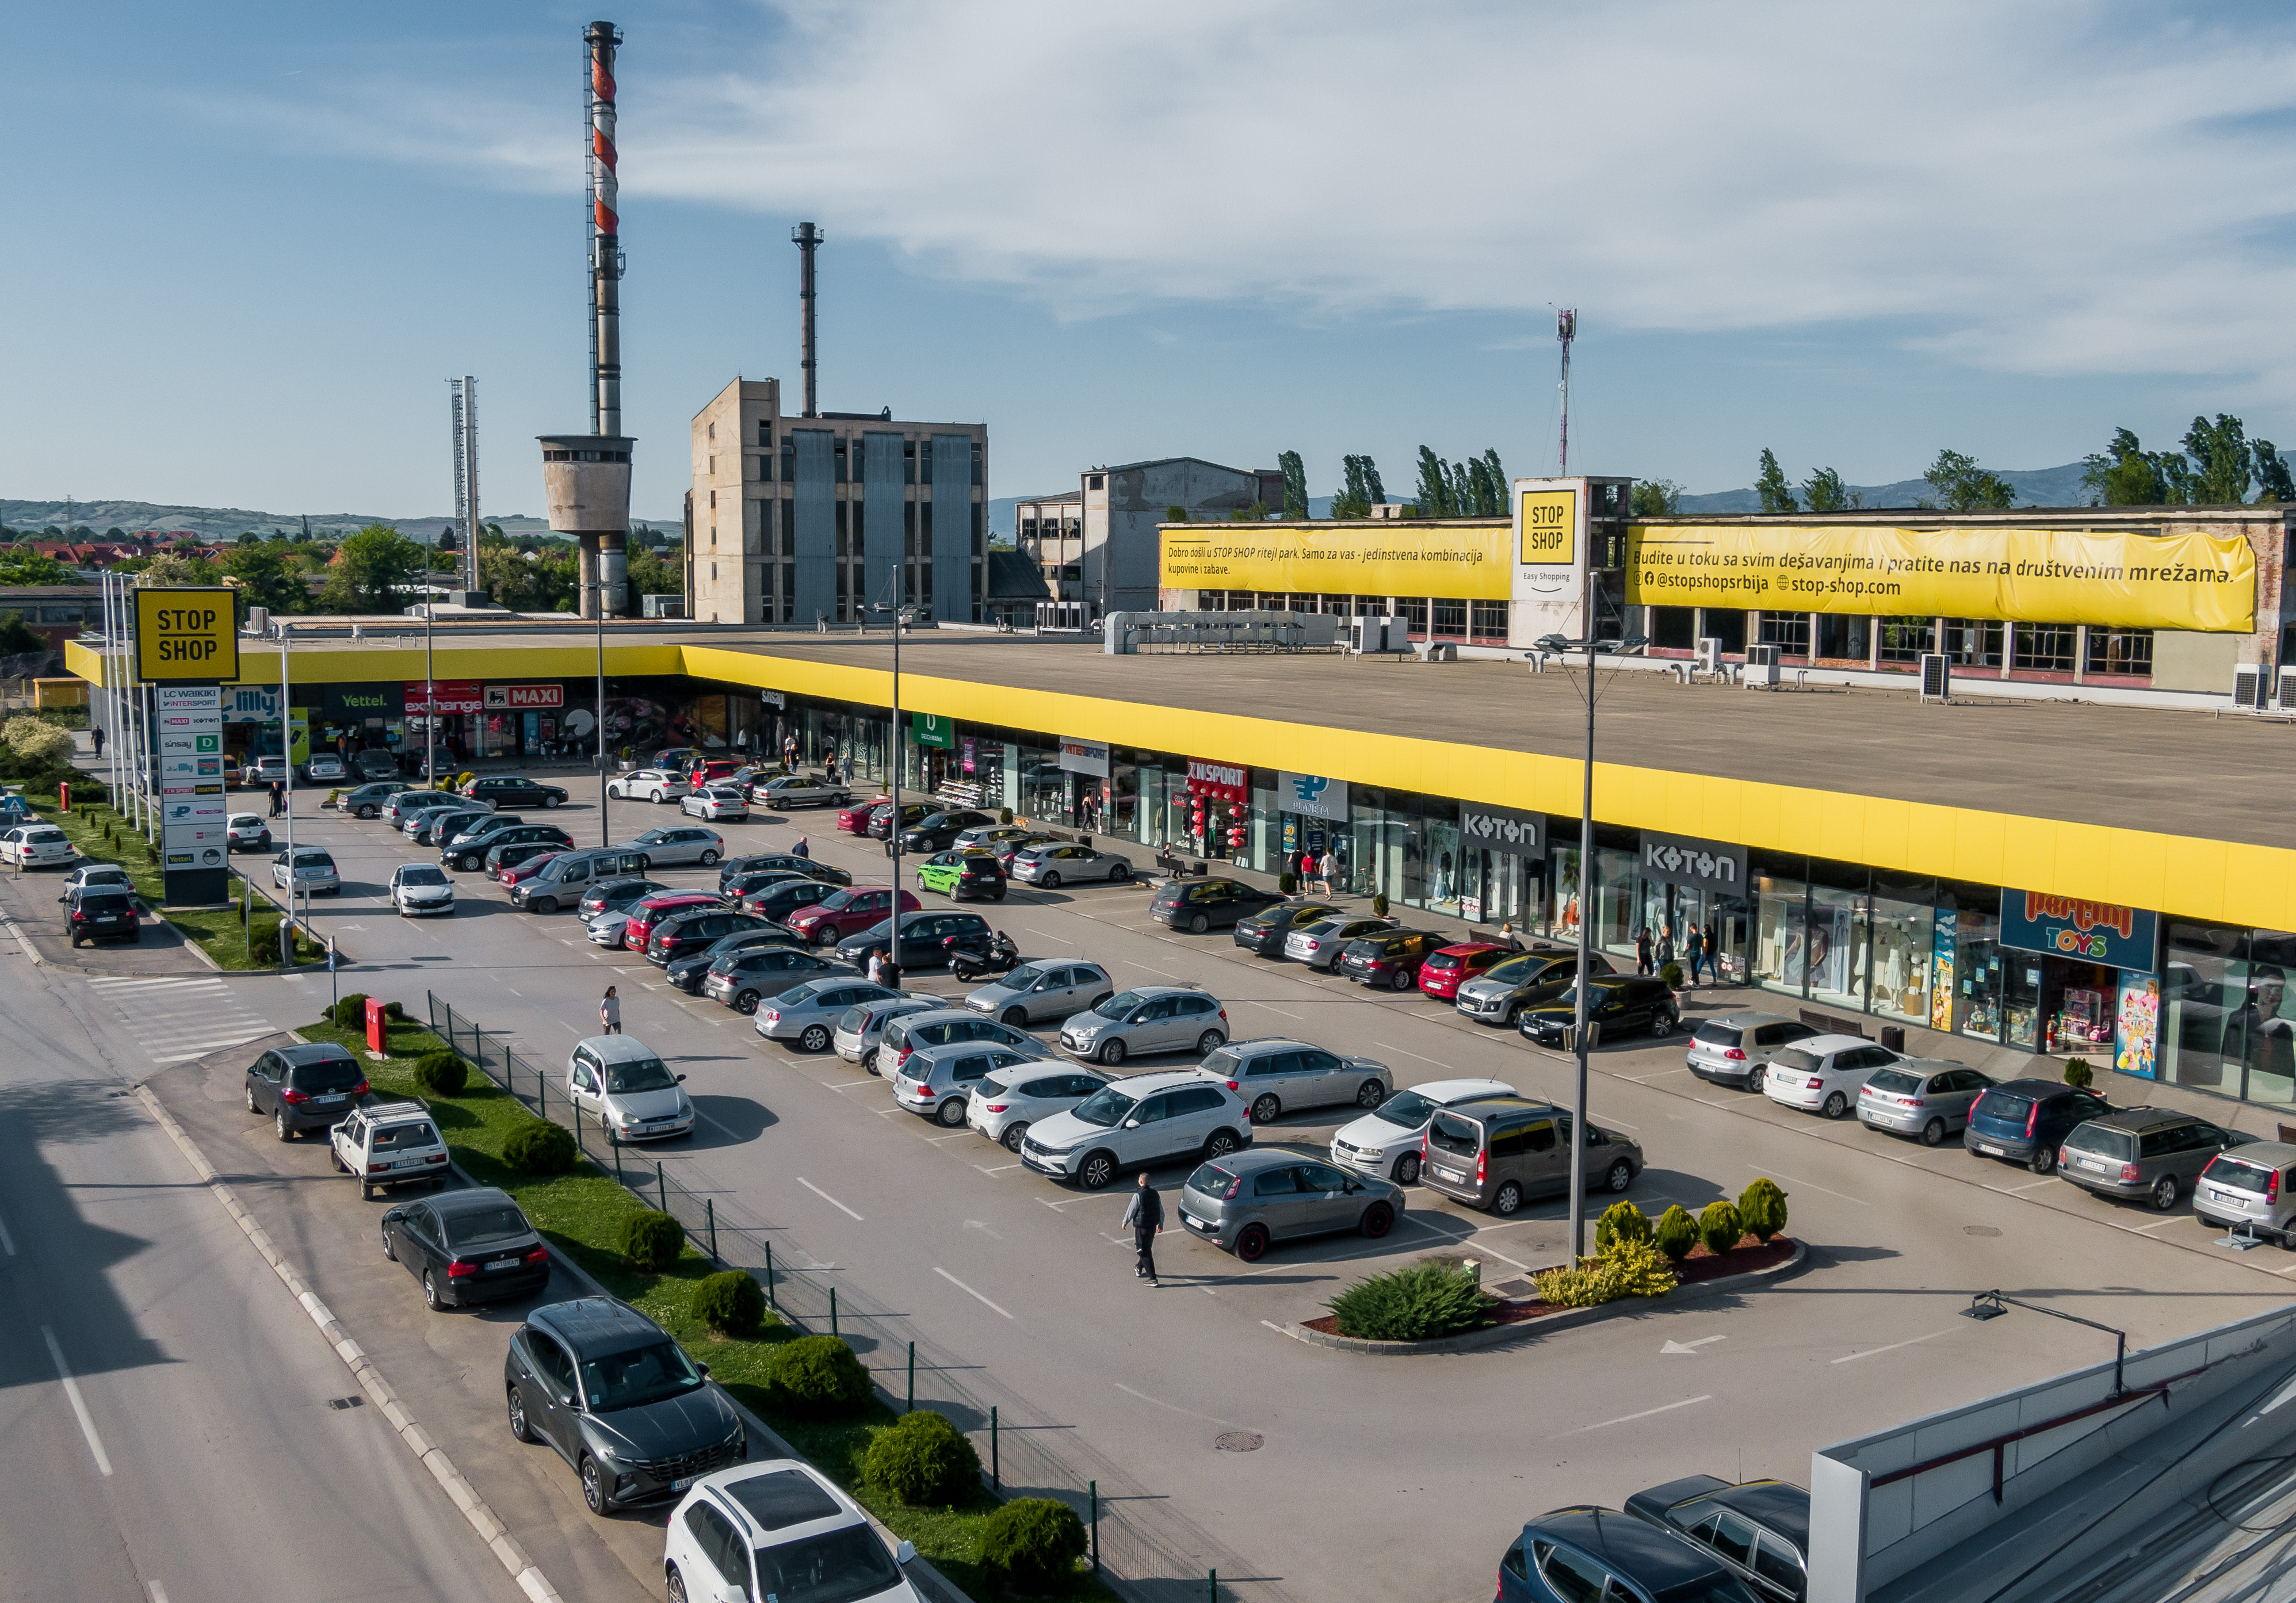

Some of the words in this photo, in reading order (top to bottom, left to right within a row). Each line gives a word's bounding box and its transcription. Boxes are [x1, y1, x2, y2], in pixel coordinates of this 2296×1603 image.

[1532, 506, 1564, 523] STOP
[1531, 532, 1563, 549] SHOP
[1168, 547, 1189, 558] Dobro
[1190, 546, 1205, 558] došli
[1207, 549, 1212, 558] u
[1213, 547, 1232, 558] STOP
[1233, 547, 1255, 558] SHOP
[1257, 546, 1278, 561] ritejl
[1278, 546, 1300, 561] park.
[1302, 548, 1324, 560] Samo
[1327, 550, 1338, 560] za
[1340, 550, 1355, 560] vas
[1362, 548, 1418, 563] jedinstvena
[1421, 548, 1483, 565] kombinacija
[1168, 563, 1198, 576] kupovine
[1200, 563, 1202, 574] i
[1204, 563, 1230, 575] zabave.
[1633, 550, 1674, 564] Budite
[1677, 554, 1685, 564] u
[1690, 551, 1720, 565] toku
[1723, 554, 1738, 566] sa
[1742, 552, 1775, 568] svim
[1779, 552, 1874, 574] dešavanjima
[1879, 554, 1885, 570] i
[1887, 556, 1944, 575] pratite
[1950, 560, 1981, 574] nas
[1986, 561, 2011, 575] na
[2016, 558, 2123, 580] društvenim
[2129, 563, 2235, 583] mrežama.
[1524, 572, 1538, 582] Easy
[1539, 572, 1570, 583] Shopping
[1657, 572, 1769, 594] @stopshopsrbija
[1791, 576, 1901, 598] stop-shop.com
[158, 609, 216, 630] STOP
[159, 640, 217, 661] SHOP
[236, 691, 276, 717] lilly
[342, 694, 387, 707] Yettel.
[513, 689, 558, 703] MAXI
[203, 737, 213, 748] D
[1292, 801, 1330, 816] PLANETA
[2046, 927, 2107, 958] TOYS
[676, 1480, 685, 1488] VL
